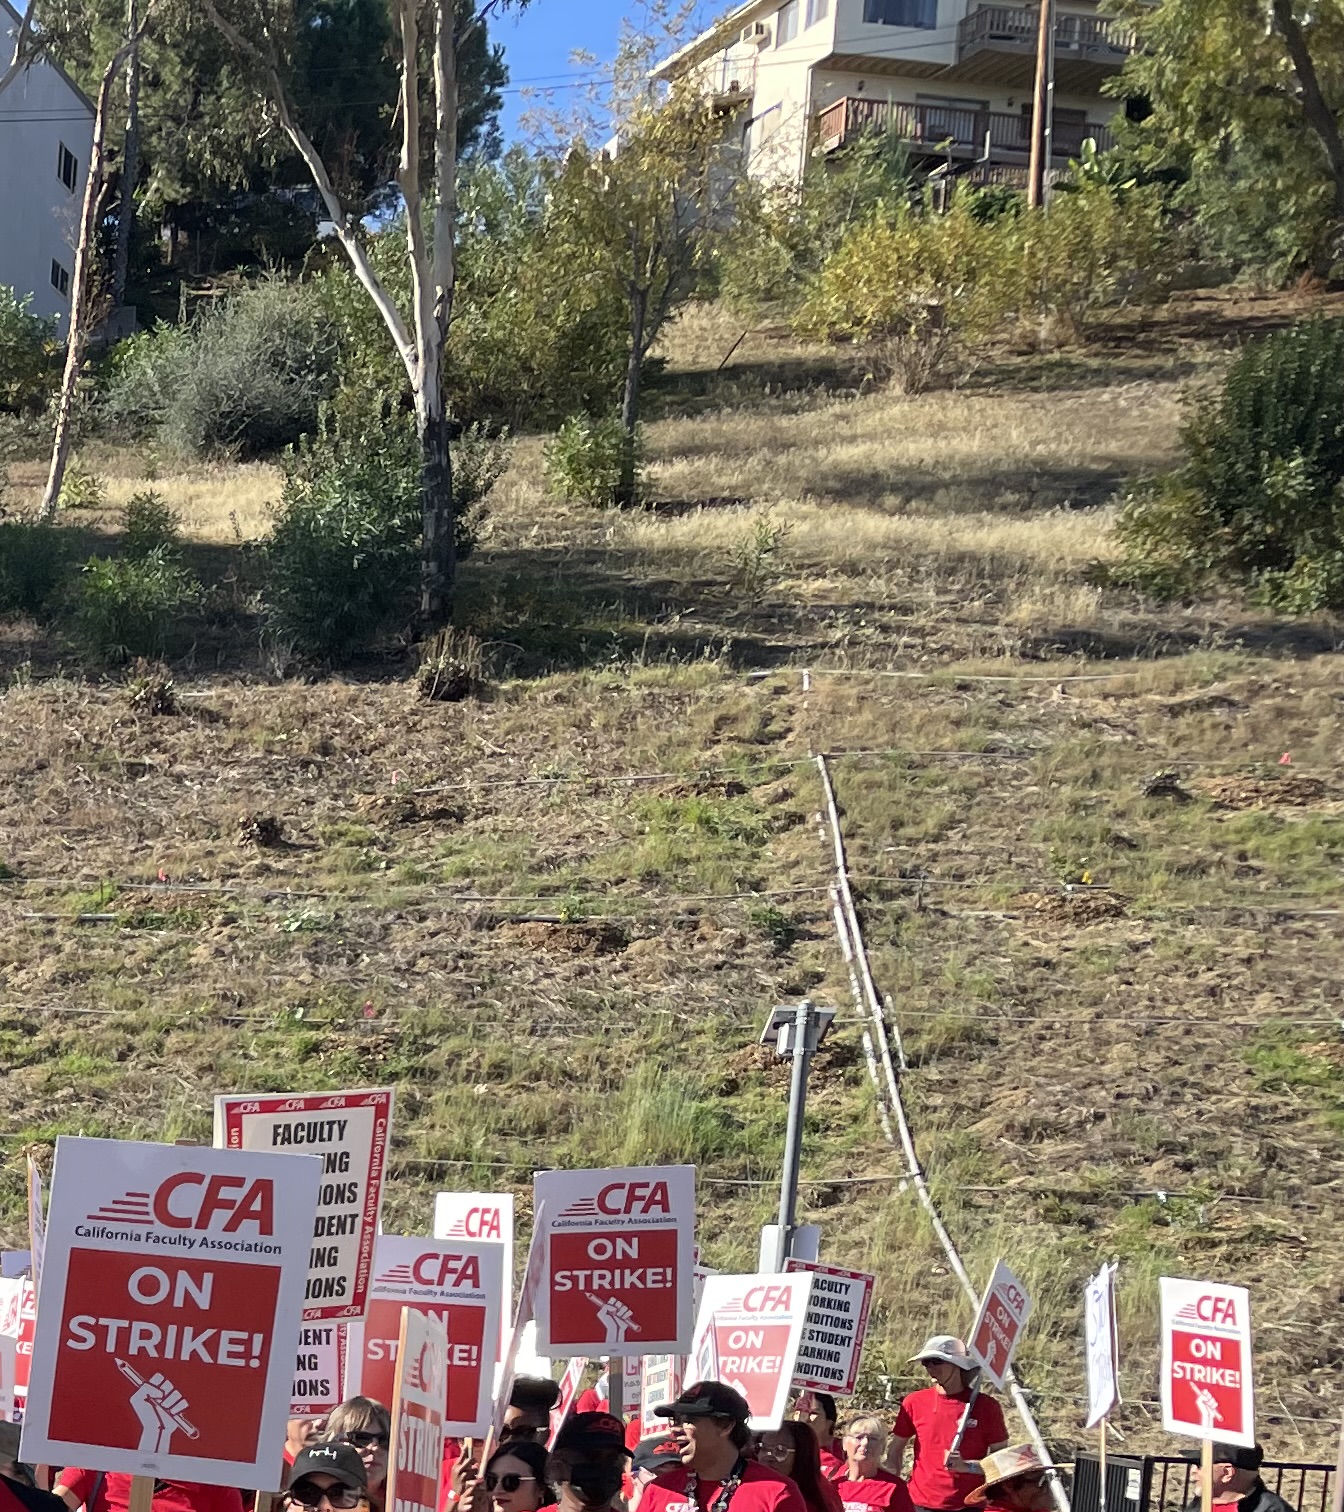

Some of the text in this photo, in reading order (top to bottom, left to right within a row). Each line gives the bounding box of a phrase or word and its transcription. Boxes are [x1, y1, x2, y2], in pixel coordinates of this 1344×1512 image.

[239, 1093, 387, 1113] CFA CFA CFA CFA
[272, 1119, 348, 1146] FACULTY
[153, 1171, 274, 1236] CFA
[356, 1118, 386, 1293] California Faculty Association
[597, 1181, 671, 1215] CFA
[313, 1213, 359, 1238] DENT
[465, 1207, 501, 1238] CFA
[551, 1217, 677, 1227] California Faculty Association
[74, 1226, 282, 1255] California Faculty Association
[587, 1237, 639, 1261] ON
[412, 1252, 480, 1288] CFA
[554, 1267, 673, 1291] STRIKE!
[128, 1266, 214, 1310] ON
[409, 1288, 438, 1298] Faculty
[439, 1290, 486, 1300] Association
[812, 1276, 851, 1296] ACULTY
[343, 1305, 362, 1316] CFA
[743, 1285, 793, 1312] CFA
[1007, 1284, 1025, 1316] CFA
[1196, 1295, 1237, 1326] CFA
[807, 1312, 854, 1331] NDITIONS
[996, 1306, 1012, 1328] ON
[66, 1315, 264, 1369] STRIKE!
[728, 1331, 764, 1349] ON
[808, 1329, 854, 1348] STUDENT
[984, 1311, 1012, 1350] STRIKE!
[799, 1344, 841, 1364] EARNING
[1190, 1339, 1222, 1360] ON
[719, 1356, 782, 1374] TRIKE!
[796, 1361, 844, 1382] NDITIONS
[1172, 1362, 1241, 1389] STRIKE!
